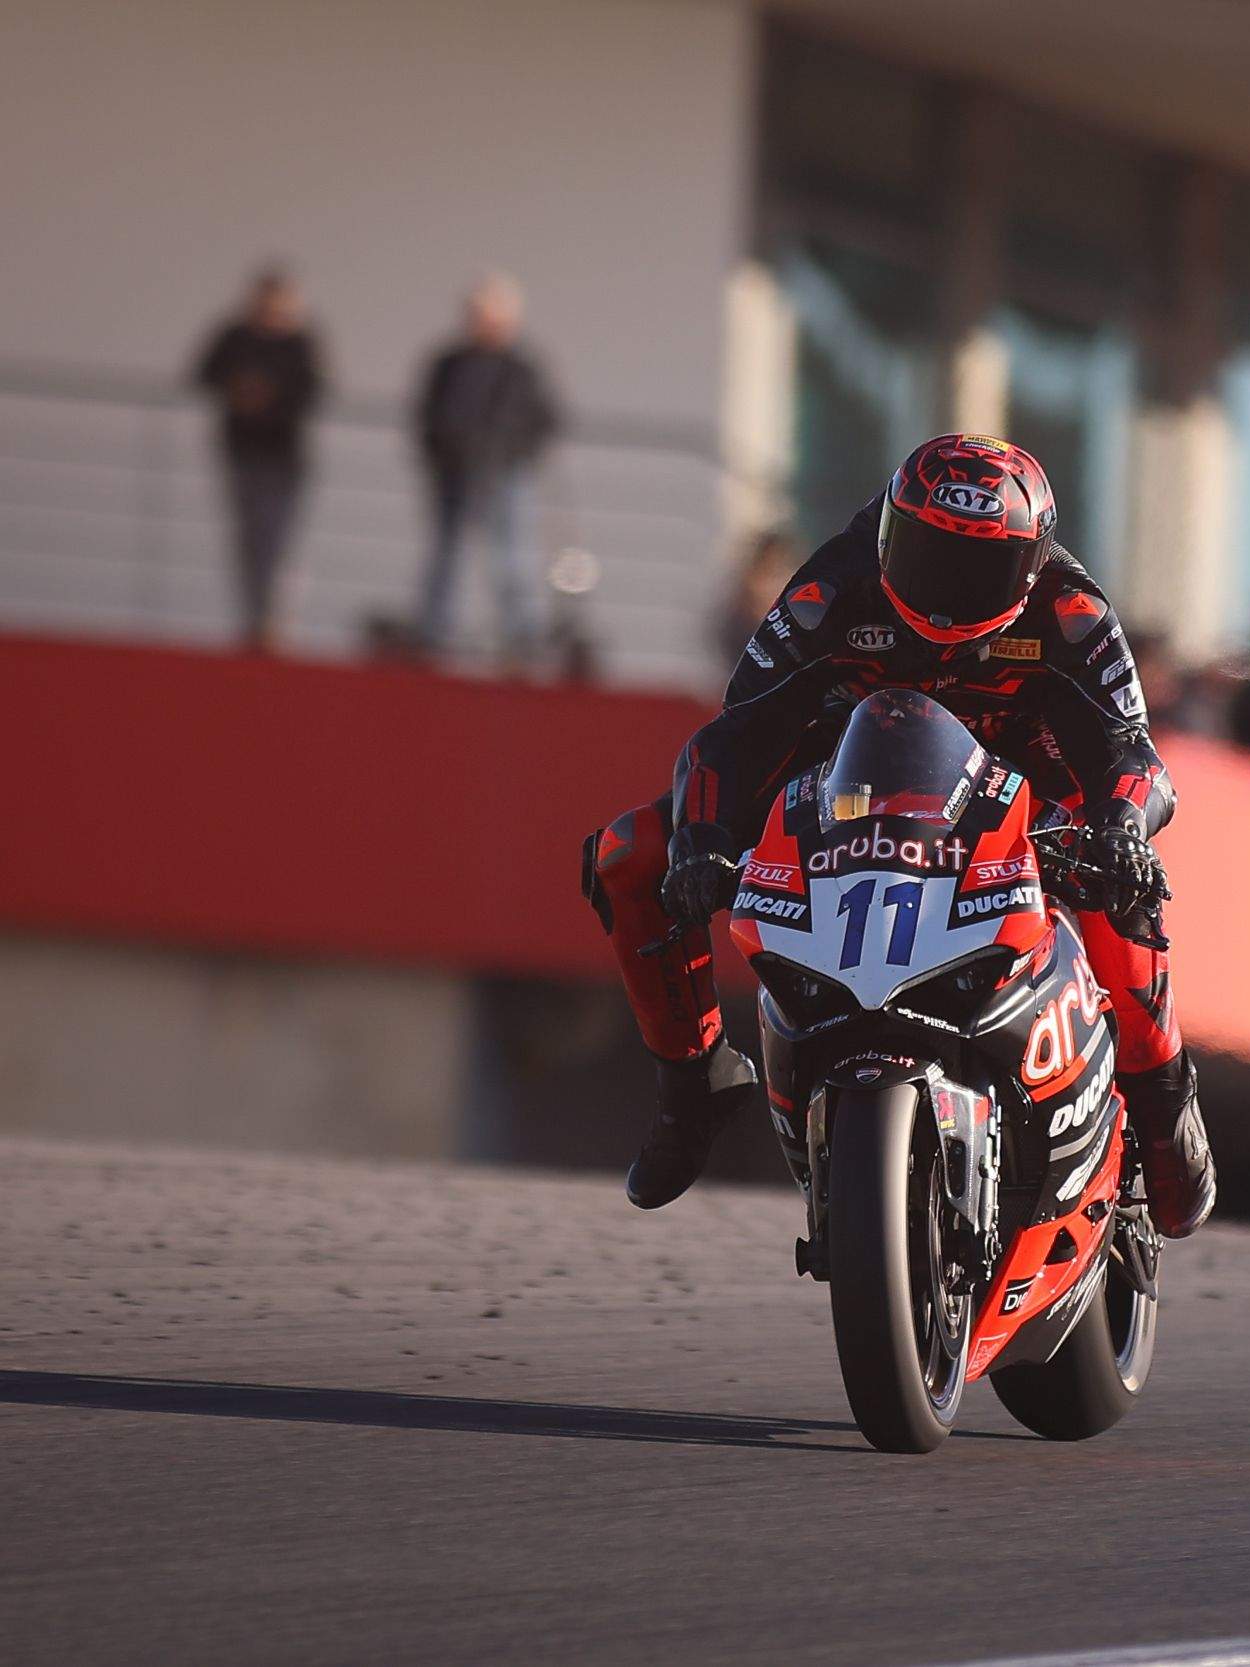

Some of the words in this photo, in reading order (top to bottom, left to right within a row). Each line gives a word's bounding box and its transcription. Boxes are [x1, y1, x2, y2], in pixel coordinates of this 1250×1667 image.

[938, 486, 1000, 511] KYT
[852, 627, 894, 647] KYT
[808, 822, 968, 871] aruba.it
[744, 863, 793, 882] STULZ
[733, 892, 807, 920] DUCATI
[957, 886, 1041, 918] DUCATI
[837, 879, 924, 971] 11
[834, 1050, 915, 1068] aruba.it
